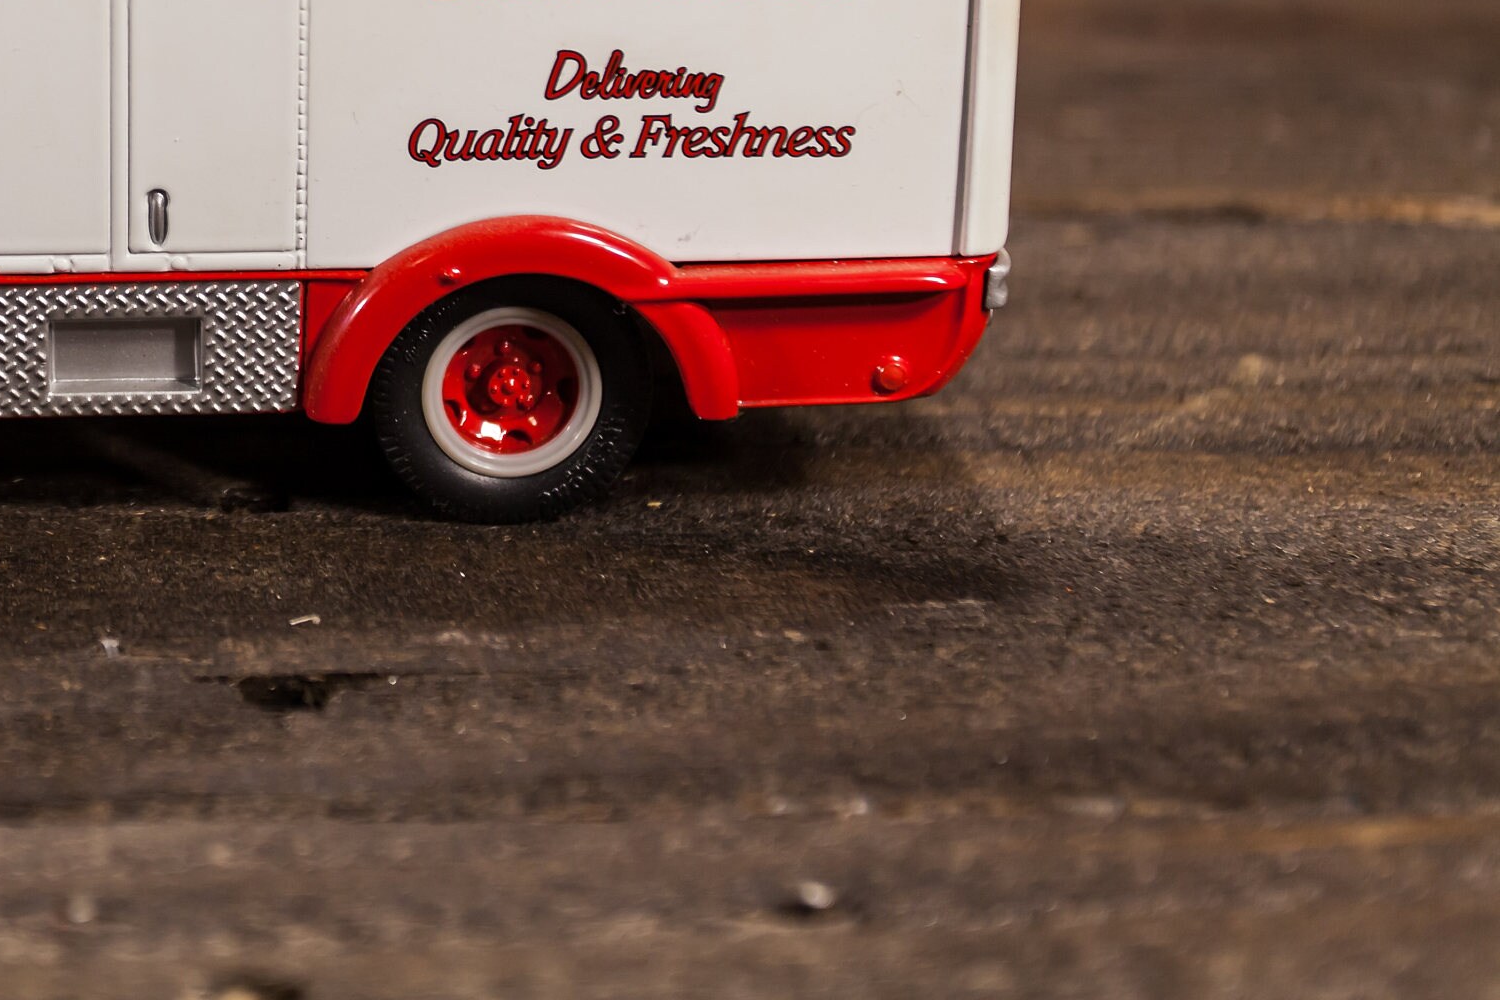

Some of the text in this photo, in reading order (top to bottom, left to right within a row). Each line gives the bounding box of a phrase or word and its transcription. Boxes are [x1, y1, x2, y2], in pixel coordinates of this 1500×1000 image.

[544, 49, 725, 113] Delivering
[408, 111, 857, 170] Quality & Freshness
